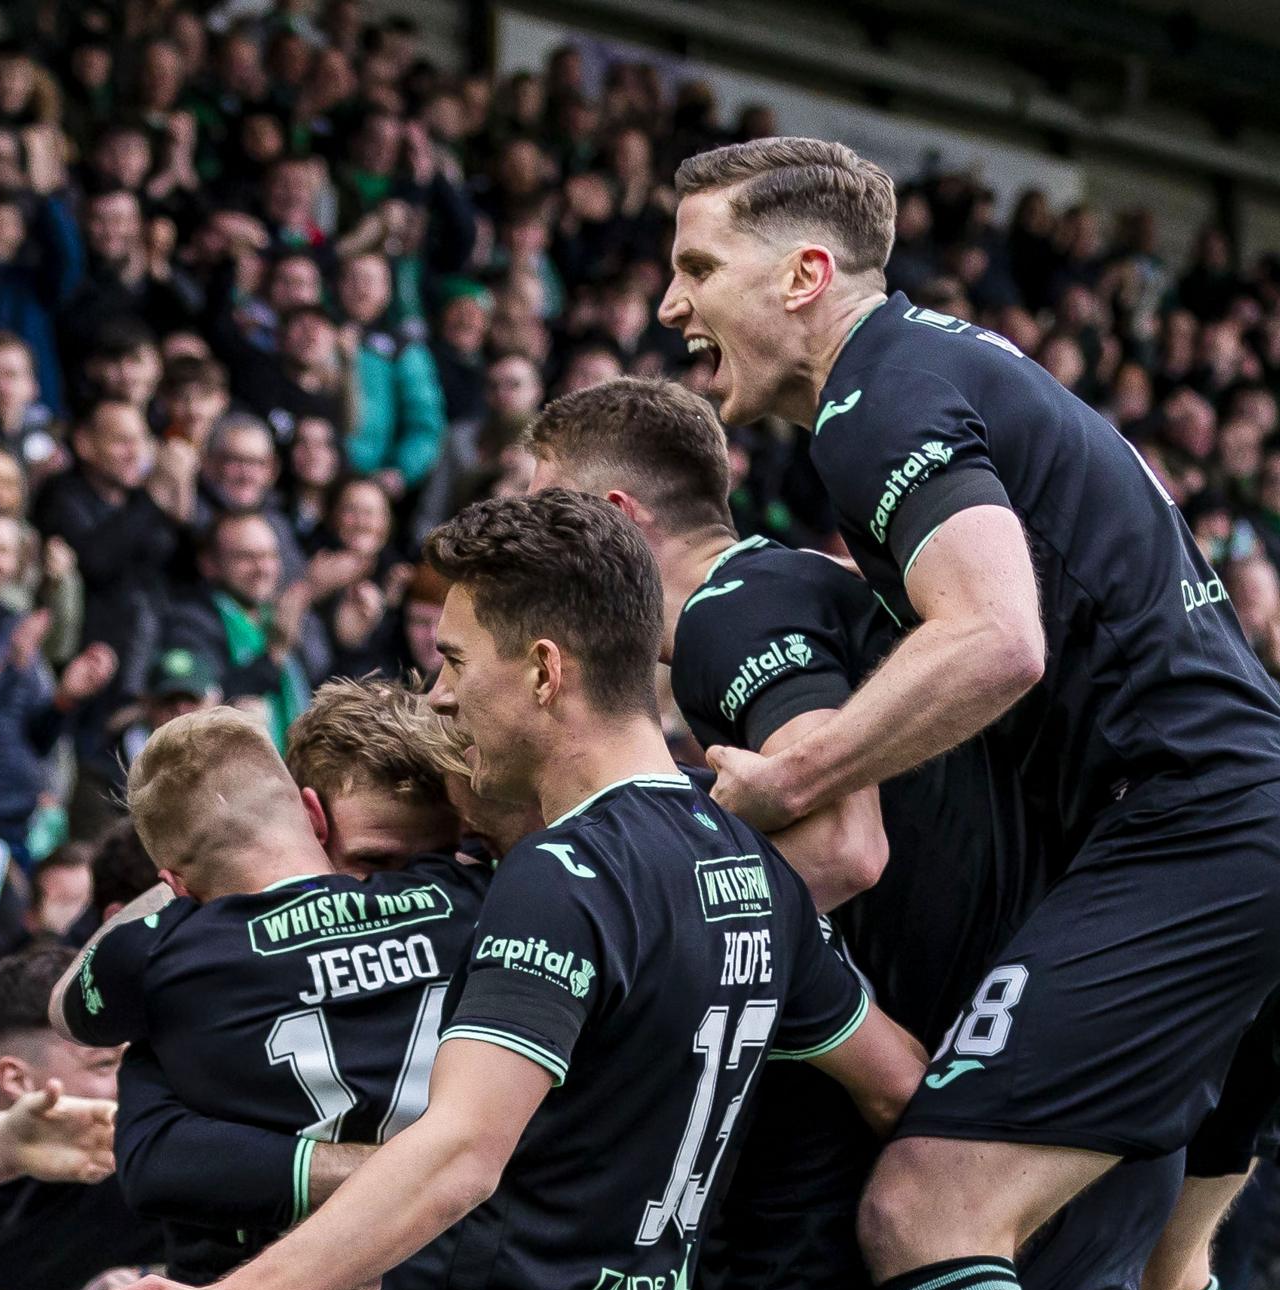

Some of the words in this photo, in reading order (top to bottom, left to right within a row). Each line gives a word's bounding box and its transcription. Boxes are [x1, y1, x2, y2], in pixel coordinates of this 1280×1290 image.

[262, 891, 367, 943] WHISKY
[298, 933, 440, 1005] JEGGO
[475, 935, 575, 978] Capital
